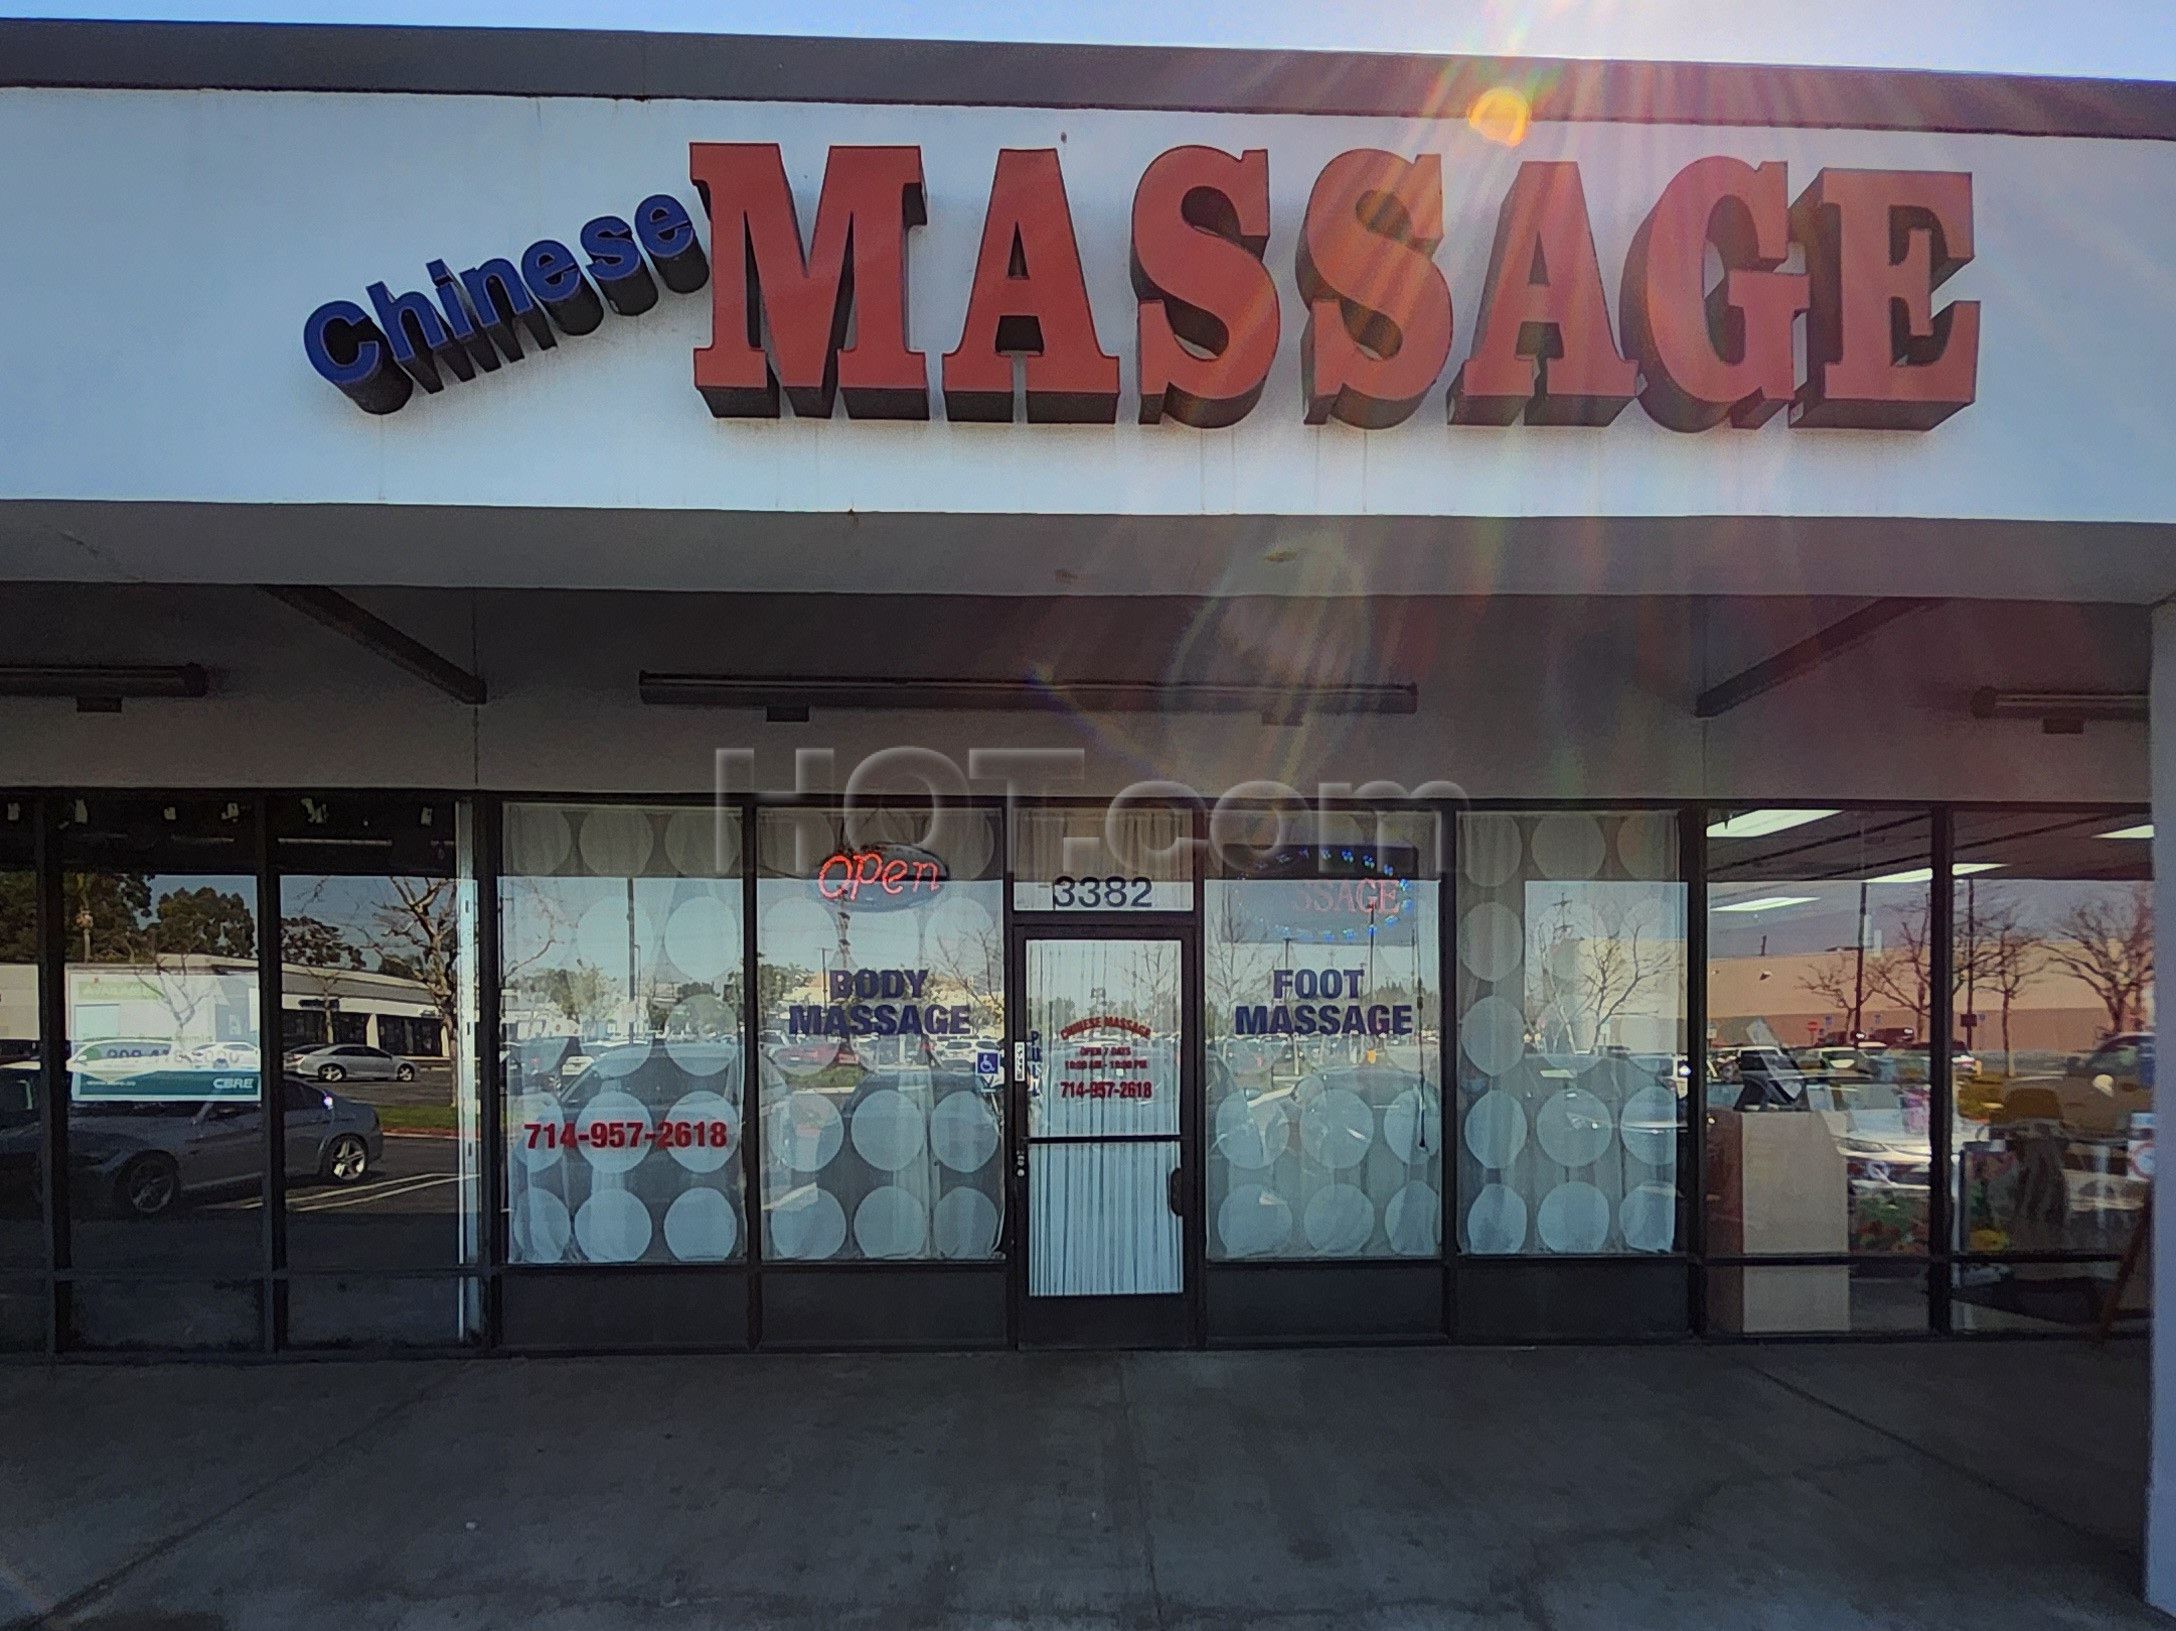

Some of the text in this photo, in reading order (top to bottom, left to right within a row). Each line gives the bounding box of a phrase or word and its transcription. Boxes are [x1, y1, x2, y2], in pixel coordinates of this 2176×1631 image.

[303, 193, 702, 390] Chinese
[689, 142, 1981, 412] MASSAGE
[1053, 876, 1153, 908] 3382
[829, 968, 930, 1000] BODY
[1272, 968, 1365, 1000] FOOT
[788, 1004, 971, 1036] MASSAGE
[1234, 1004, 1413, 1036] MASSAGE
[1060, 1081, 1152, 1099] 714-957-2618
[524, 1120, 728, 1150] 714-957-2618
